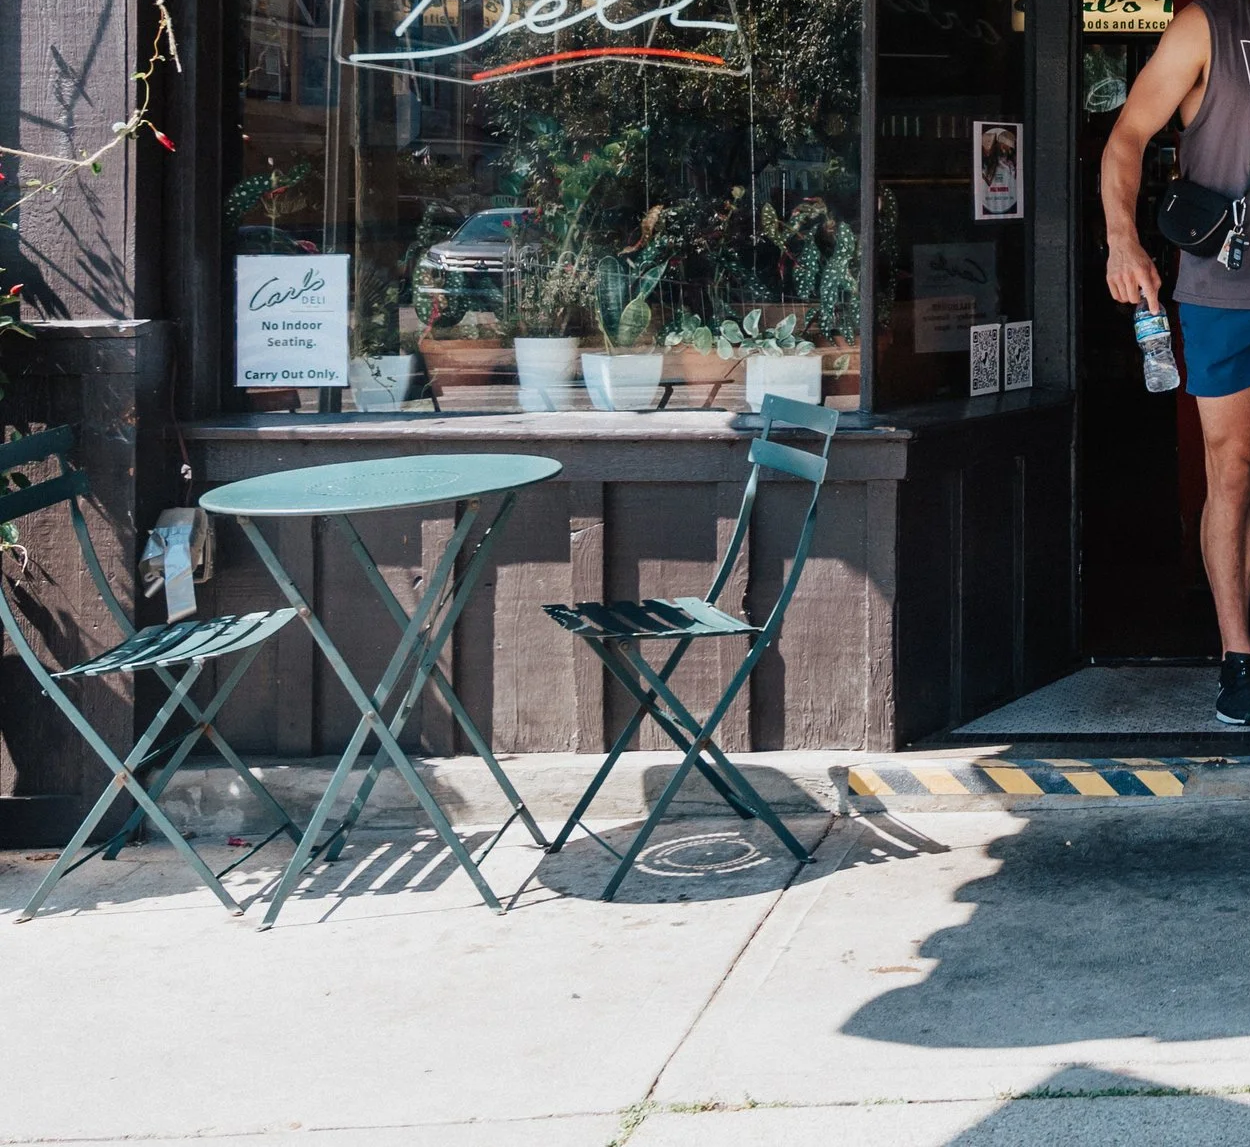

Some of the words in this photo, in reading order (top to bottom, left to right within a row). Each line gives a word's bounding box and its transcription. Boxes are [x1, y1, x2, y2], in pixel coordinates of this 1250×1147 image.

[1113, 18, 1134, 29] and
[301, 295, 325, 305] DELI
[261, 321, 279, 331] No
[282, 320, 322, 331] Indoor
[267, 337, 317, 349] Seating.
[245, 370, 278, 381] Carry
[281, 369, 304, 380] Out
[307, 368, 339, 381] Only.
